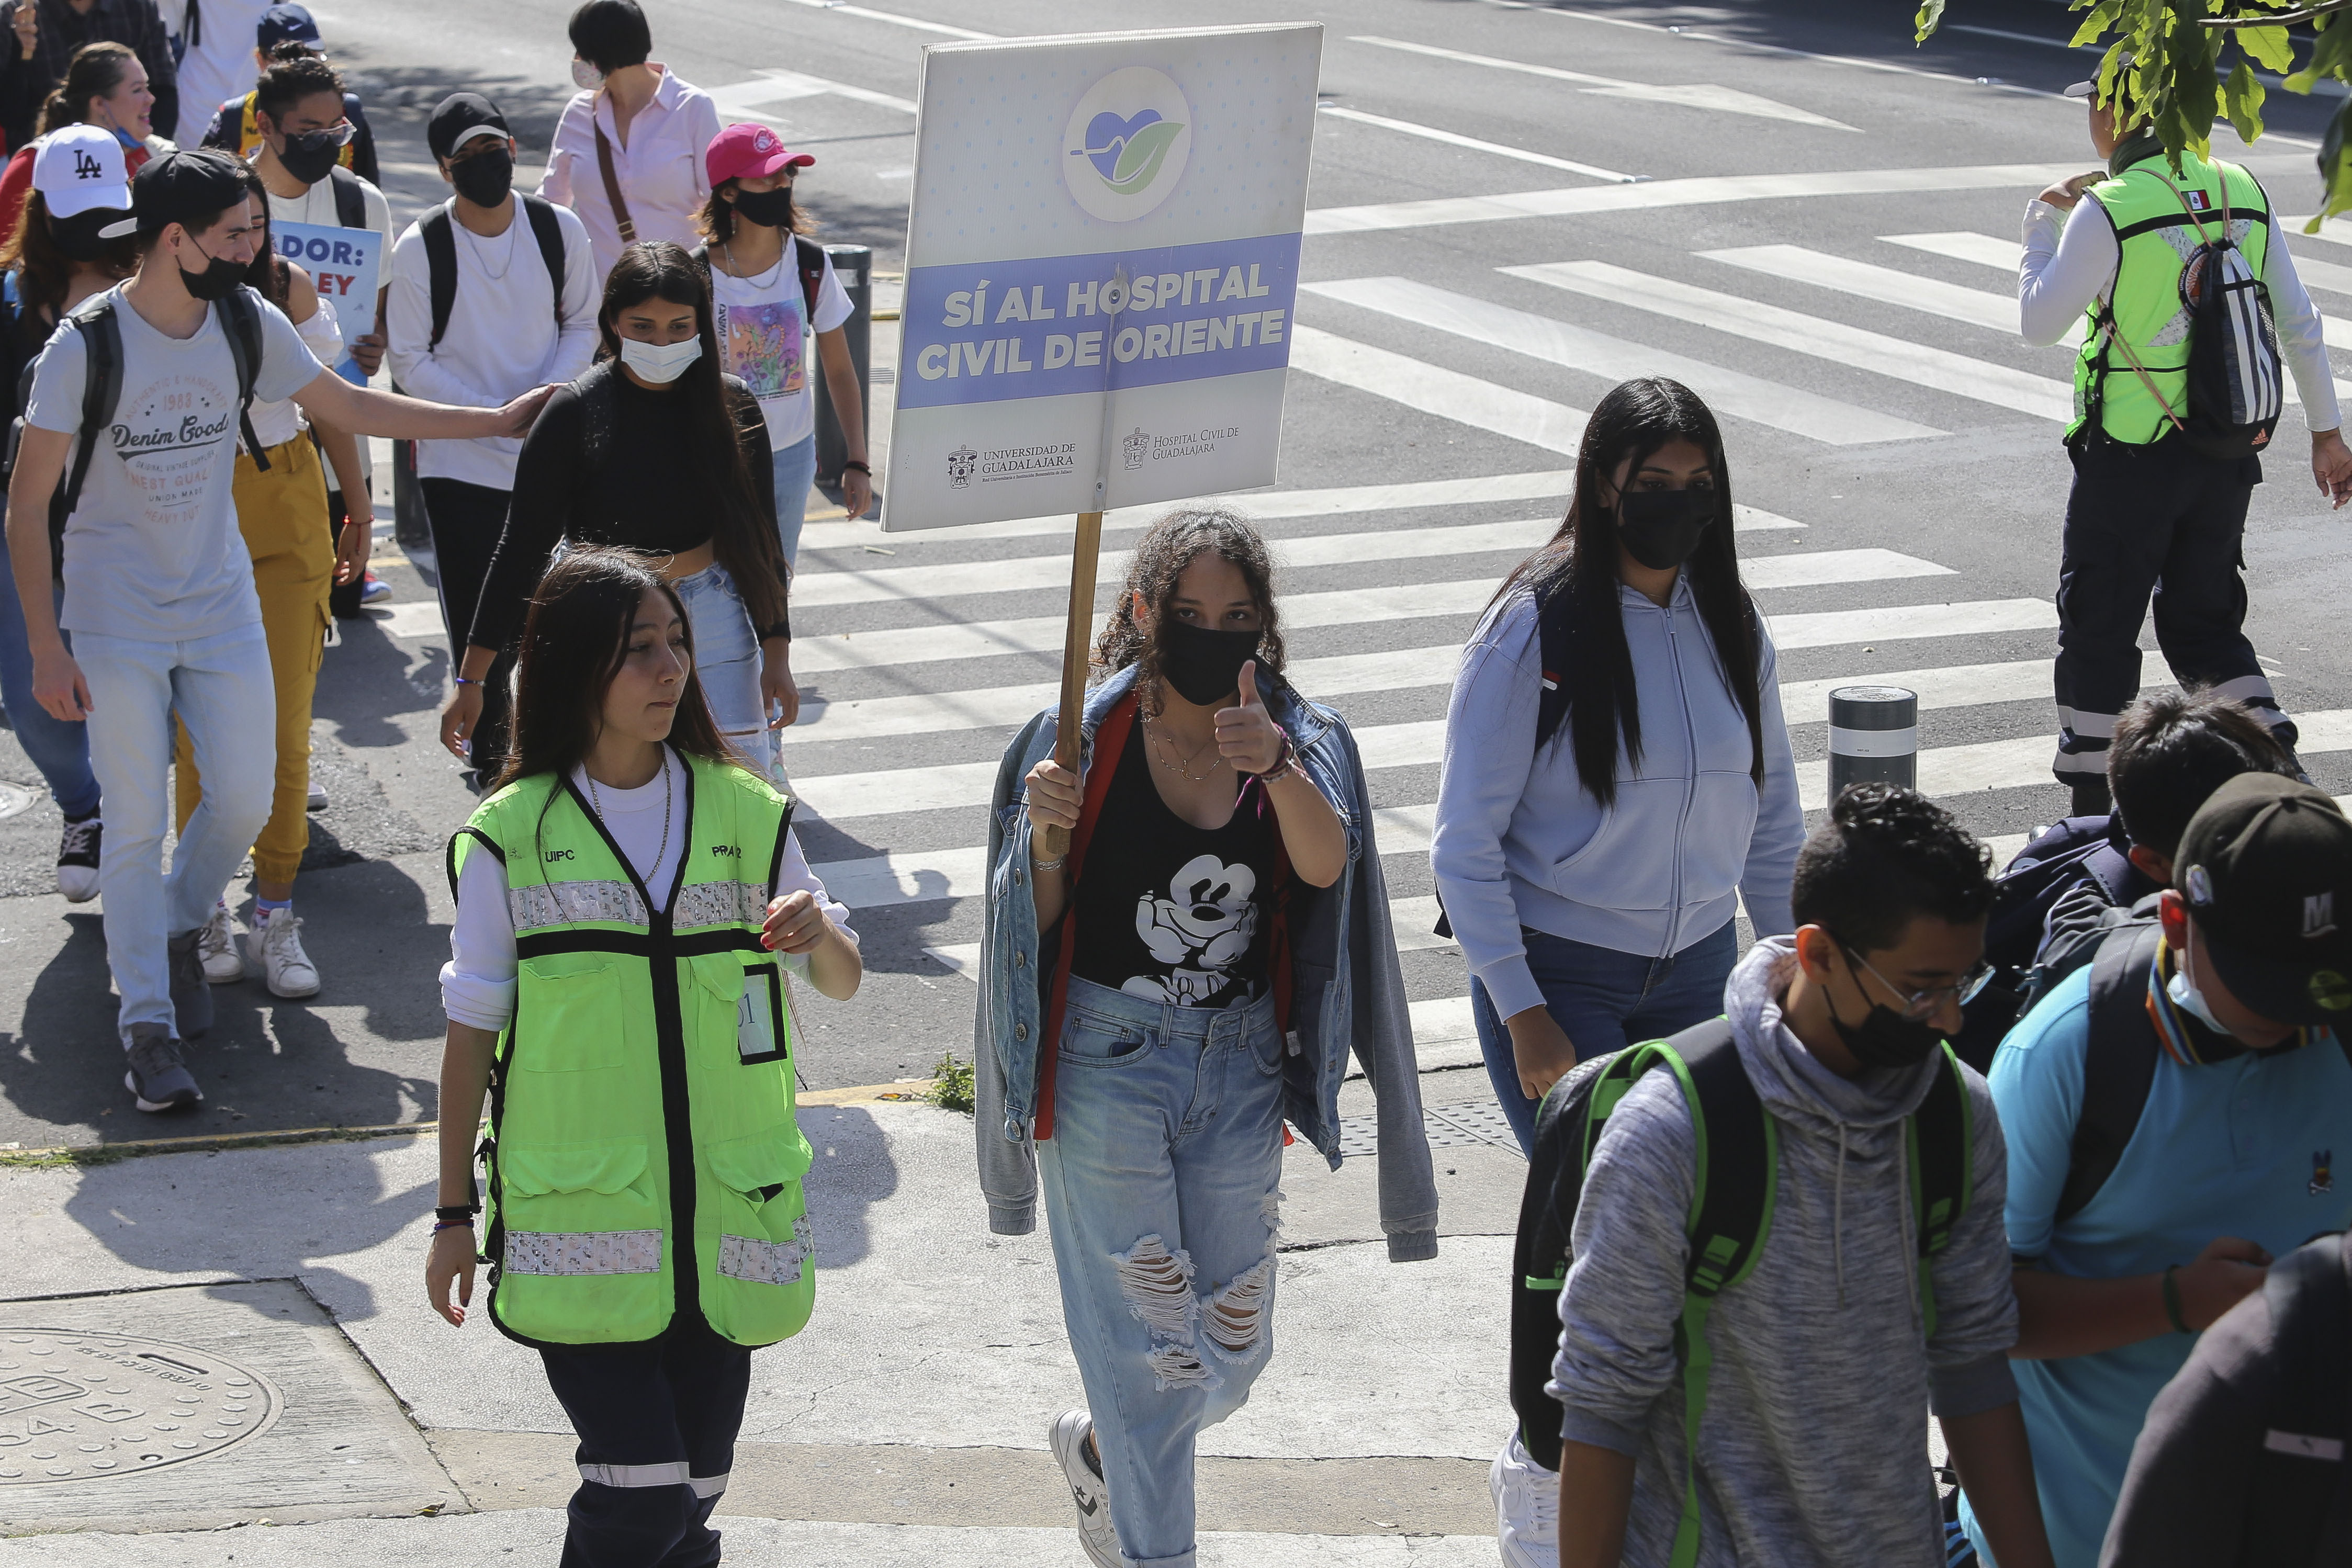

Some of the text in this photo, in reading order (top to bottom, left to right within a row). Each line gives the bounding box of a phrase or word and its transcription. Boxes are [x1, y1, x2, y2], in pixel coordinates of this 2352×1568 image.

[74, 150, 102, 179] LA
[271, 234, 364, 266] DOR:
[306, 271, 356, 296] EY
[942, 264, 1269, 328] SÍ AL HOSPITAL
[917, 309, 1285, 381] CIVIL DE ORIENTE
[111, 424, 176, 448] Denim
[1154, 433, 1197, 448] HOSPITAL
[1201, 429, 1224, 442] CIVIL
[1227, 427, 1239, 438] DE
[983, 445, 1058, 460] UNIVERSIDAD
[1061, 443, 1076, 453] DE
[1152, 443, 1215, 460] GUADALAJARA
[982, 455, 1074, 473] GUADALAJARA
[149, 487, 202, 502] UNION MADE
[184, 504, 200, 522] DUT
[545, 849, 575, 863] UIPC
